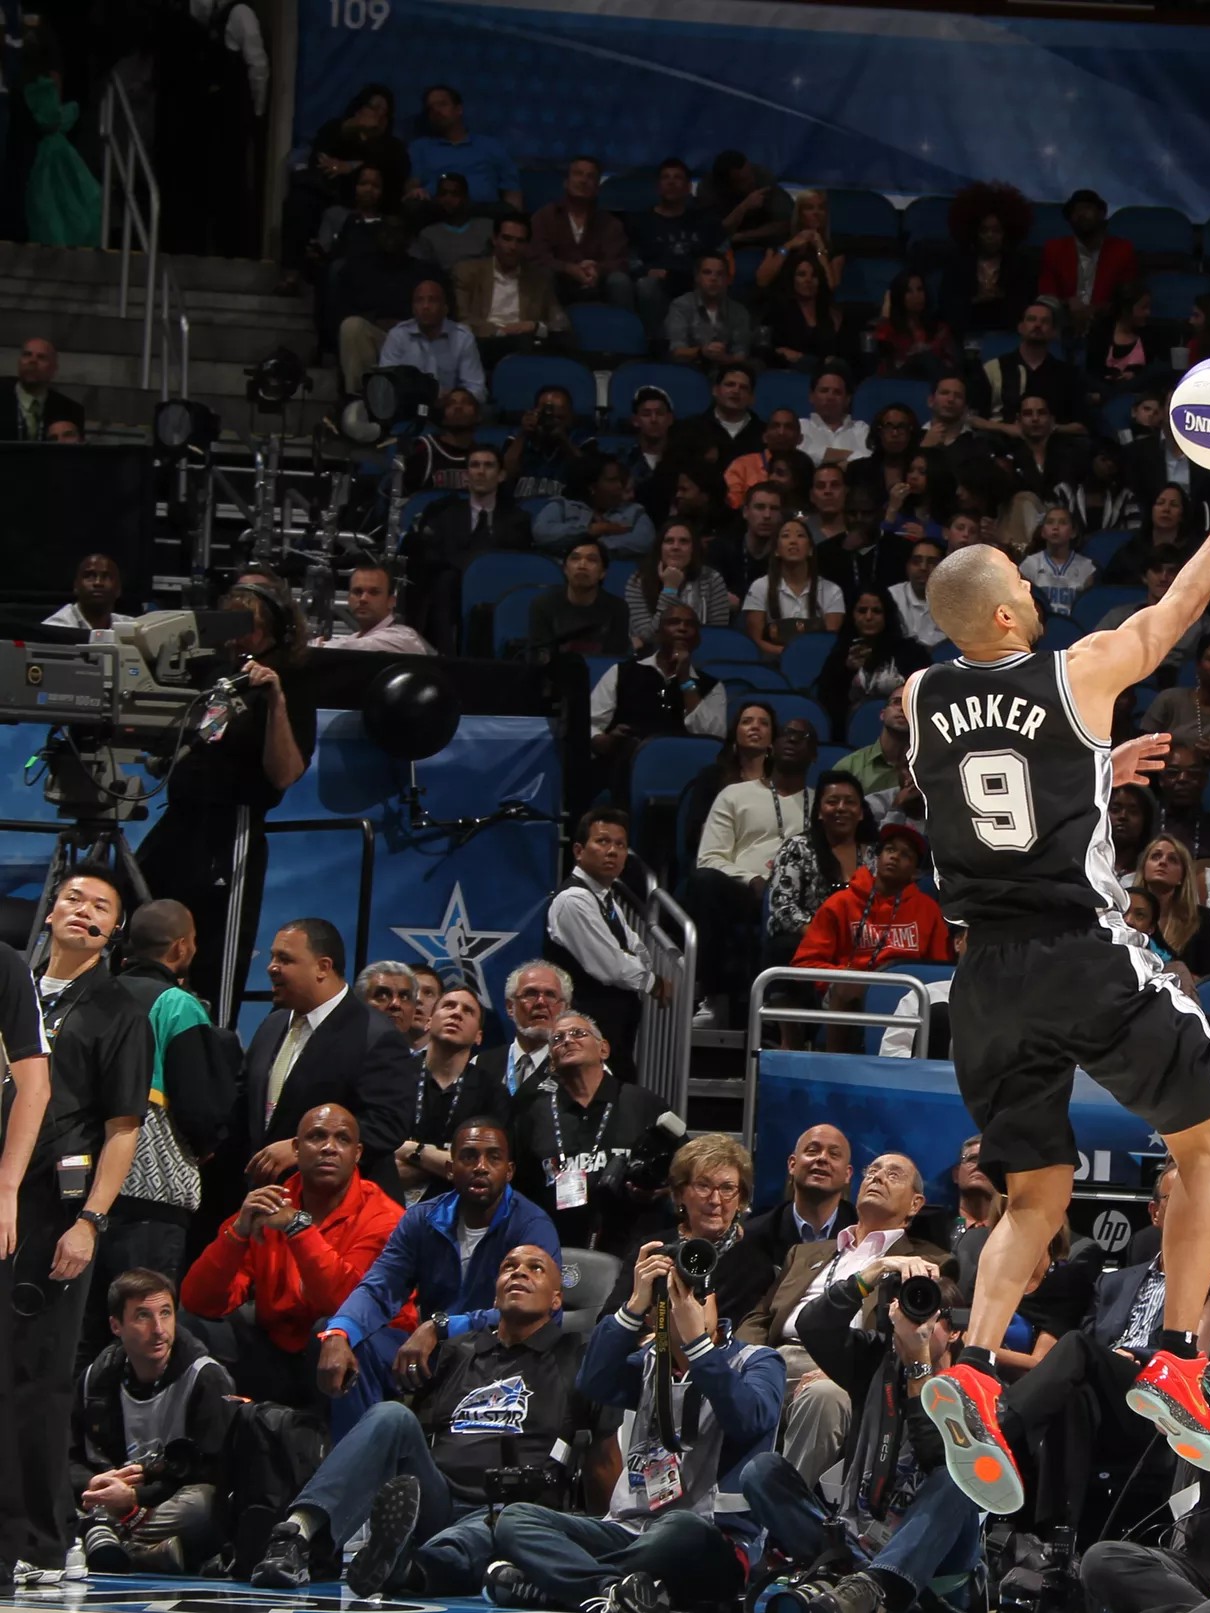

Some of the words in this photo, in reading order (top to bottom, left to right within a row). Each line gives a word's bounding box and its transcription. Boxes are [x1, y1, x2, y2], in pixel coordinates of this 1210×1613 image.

[330, 0, 390, 30] 109
[930, 693, 1048, 745] PARKER
[958, 747, 1039, 853] 9
[1097, 1209, 1129, 1253] hp
[658, 1301, 667, 1329] Nikon
